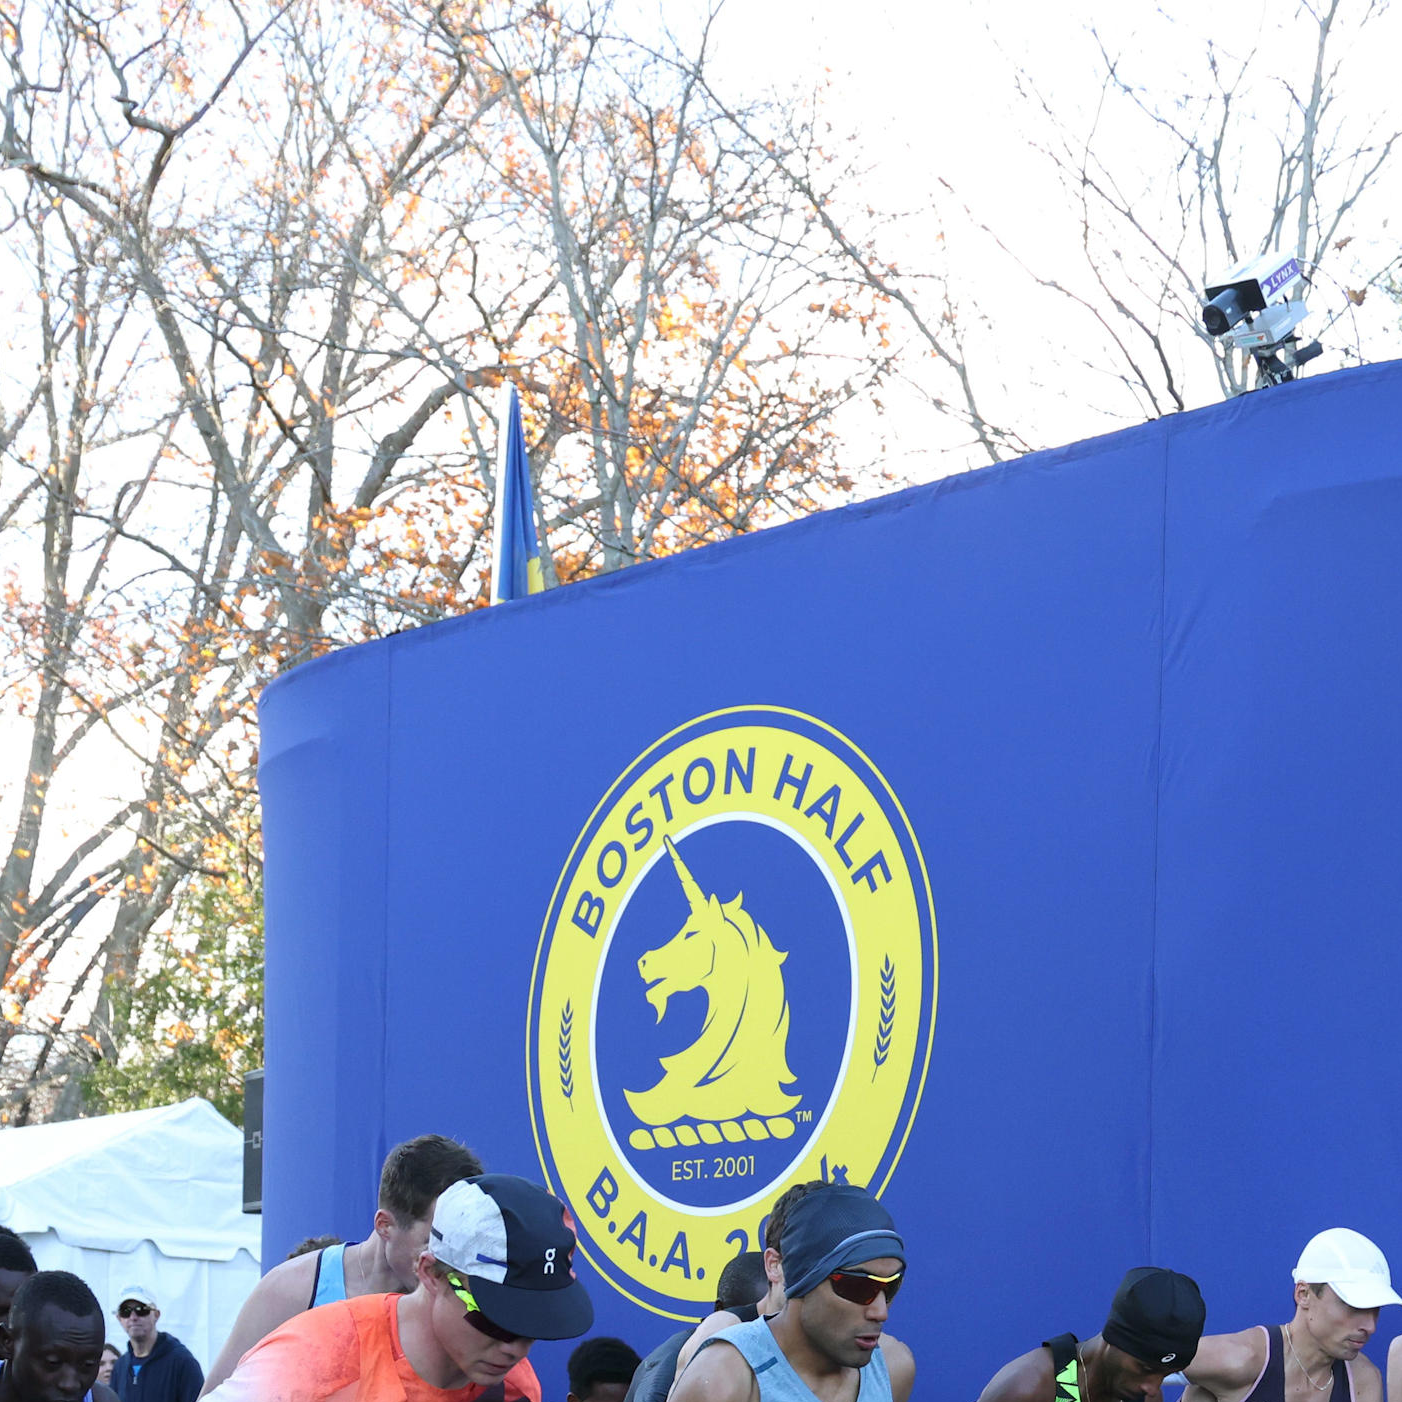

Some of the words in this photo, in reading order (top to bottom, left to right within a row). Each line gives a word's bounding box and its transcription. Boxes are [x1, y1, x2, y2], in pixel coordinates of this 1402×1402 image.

[1270, 263, 1295, 287] LYNX
[571, 746, 757, 939] BOSTON
[773, 753, 894, 894] HALF
[671, 1159, 710, 1182] EST.
[713, 1155, 756, 1179] 2001
[586, 1165, 707, 1282] B.A.A.
